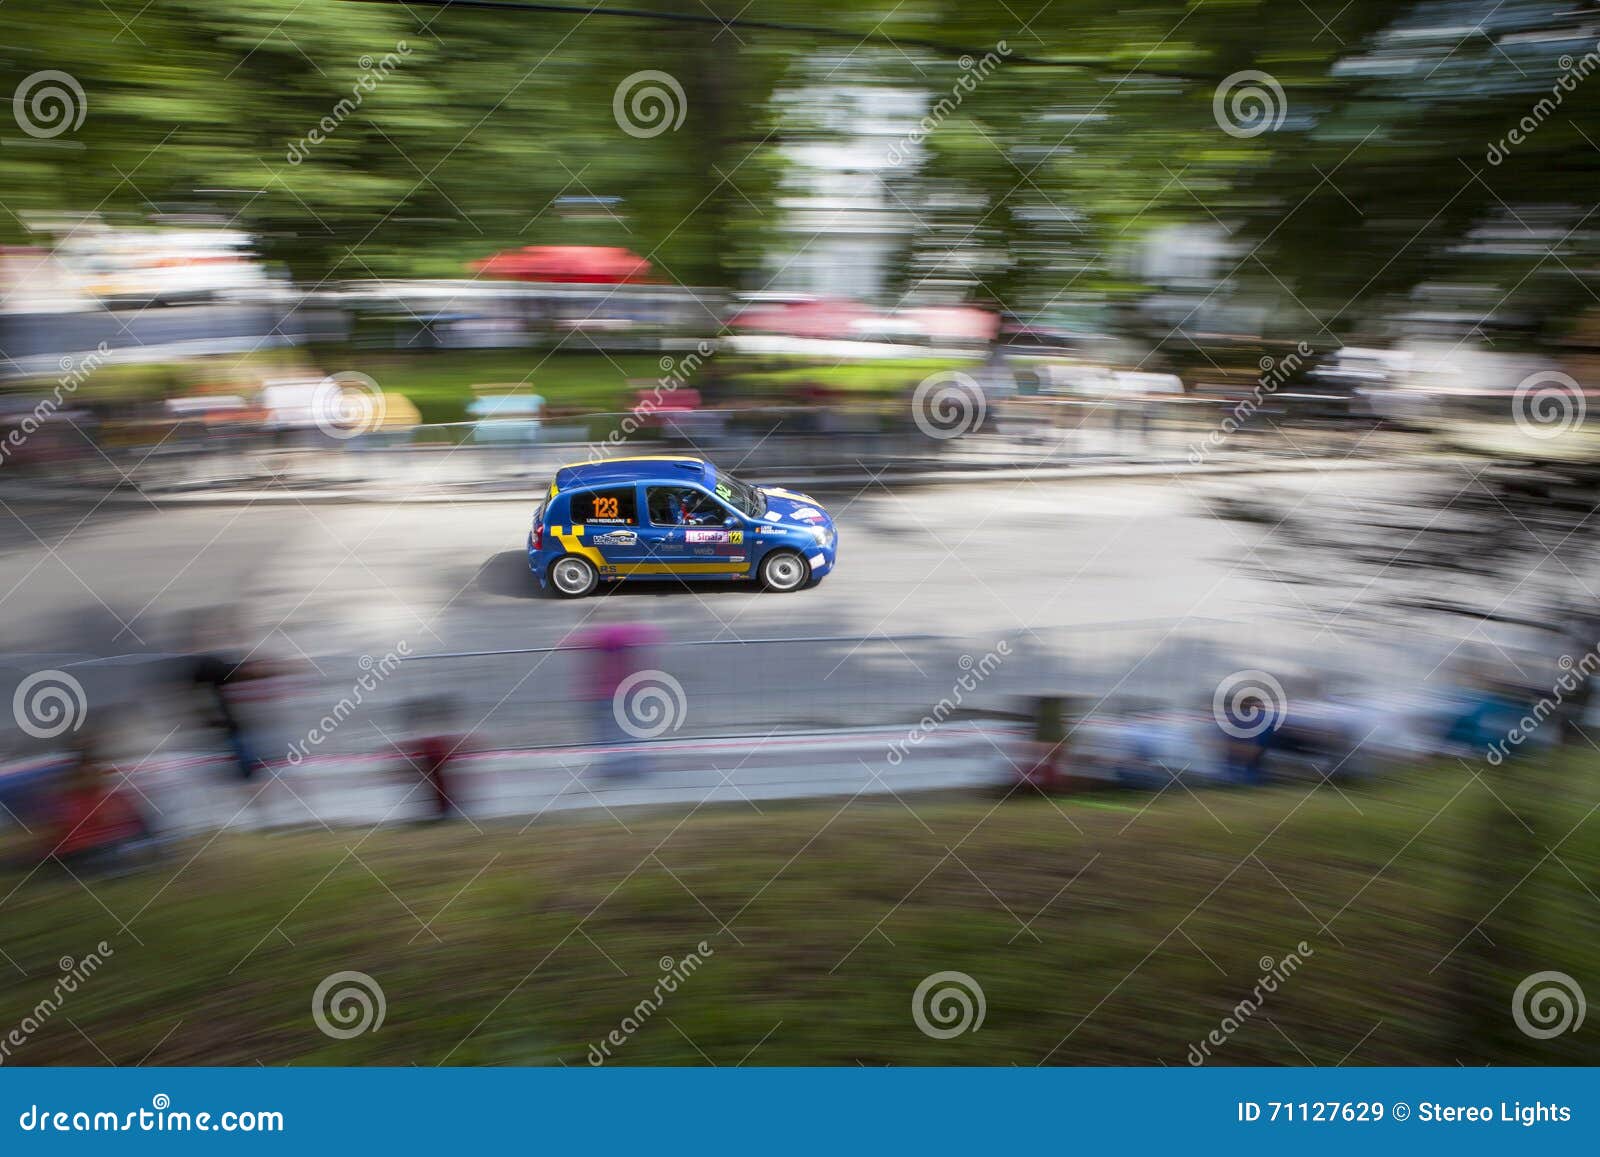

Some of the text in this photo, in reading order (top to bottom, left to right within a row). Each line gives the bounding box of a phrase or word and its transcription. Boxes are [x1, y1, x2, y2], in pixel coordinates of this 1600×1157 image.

[593, 497, 618, 518] 123
[697, 532, 723, 541] Sinaia
[729, 532, 741, 544] 123
